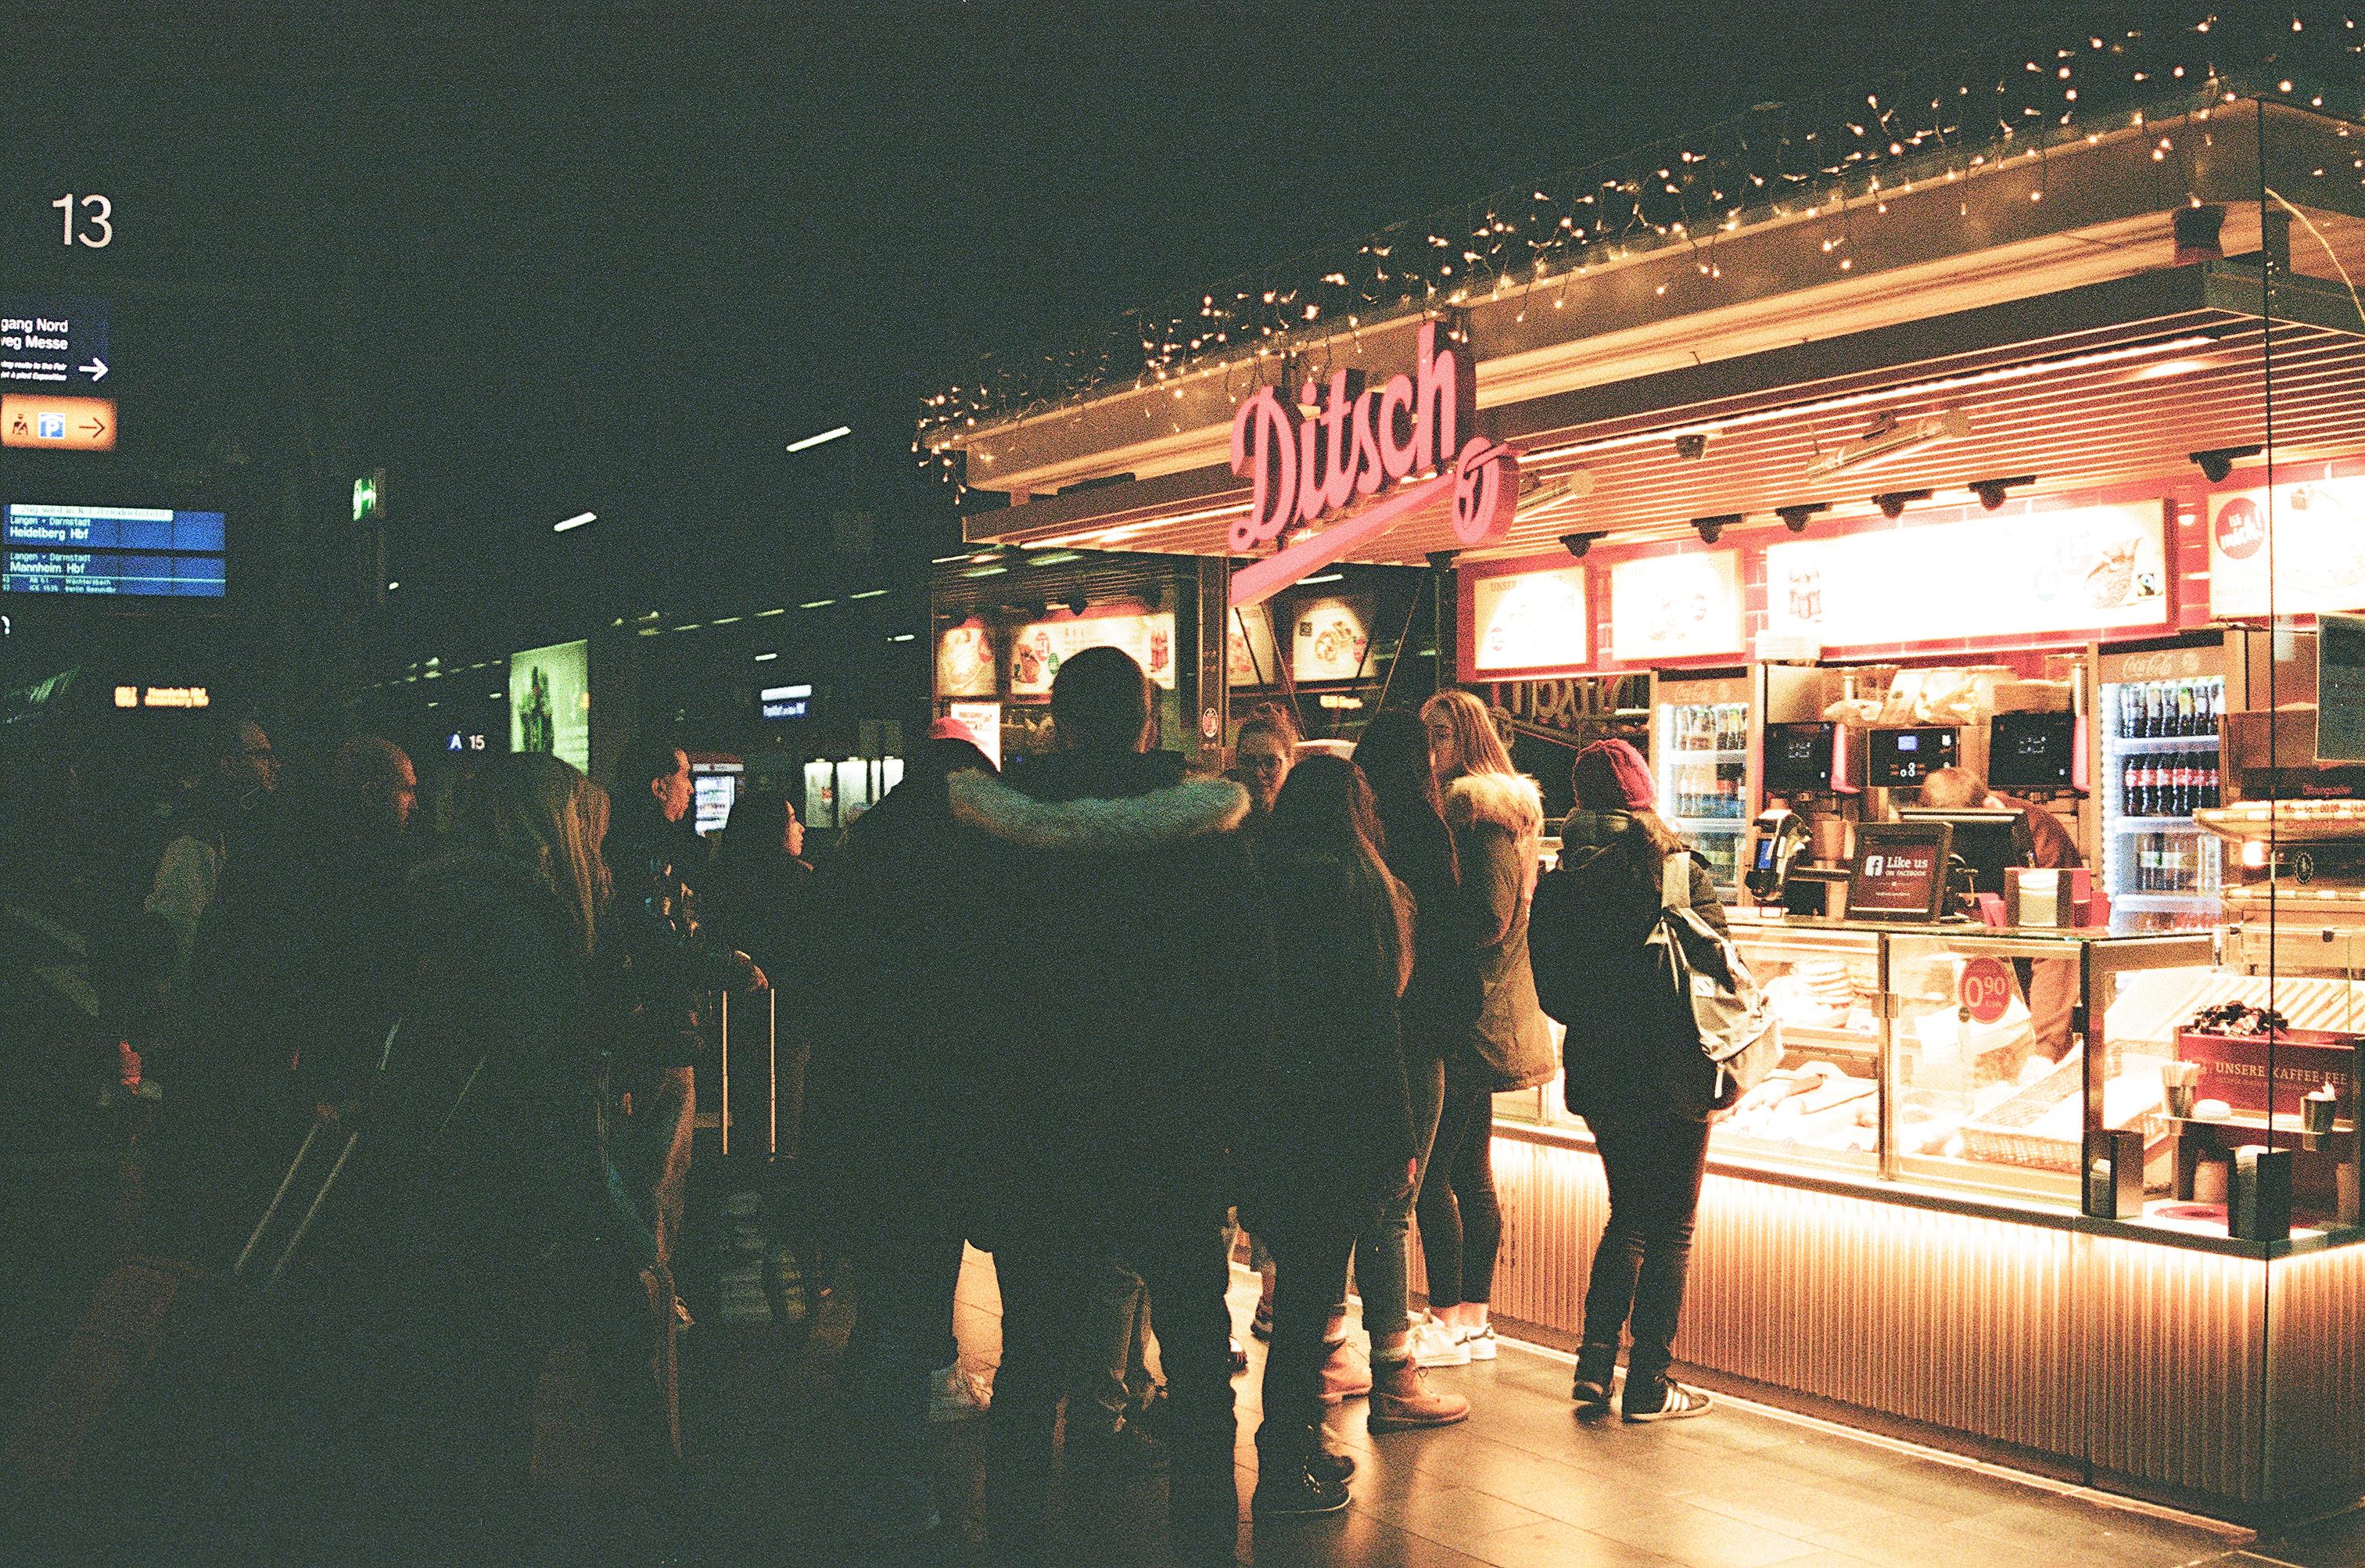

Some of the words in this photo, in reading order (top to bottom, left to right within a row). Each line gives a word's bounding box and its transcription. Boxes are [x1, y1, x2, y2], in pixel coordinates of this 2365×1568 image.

[52, 193, 113, 248] 13
[36, 318, 68, 333] Nord
[25, 335, 68, 350] Messe
[1229, 321, 1456, 552] Ditsch
[10, 516, 38, 526] Langen
[49, 517, 91, 526] Darmstadt
[10, 526, 66, 541] Heidelberg
[70, 528, 88, 540] Hbf
[10, 552, 38, 562] Langen
[49, 553, 91, 562] Darmstadt
[10, 562, 62, 573] Mannheim
[66, 563, 85, 573] Hbf
[450, 734, 462, 749] A
[468, 734, 486, 750] 15
[1886, 856, 1911, 868] Like
[1914, 859, 1928, 868] us
[2216, 1061, 2265, 1077] UNSERE
